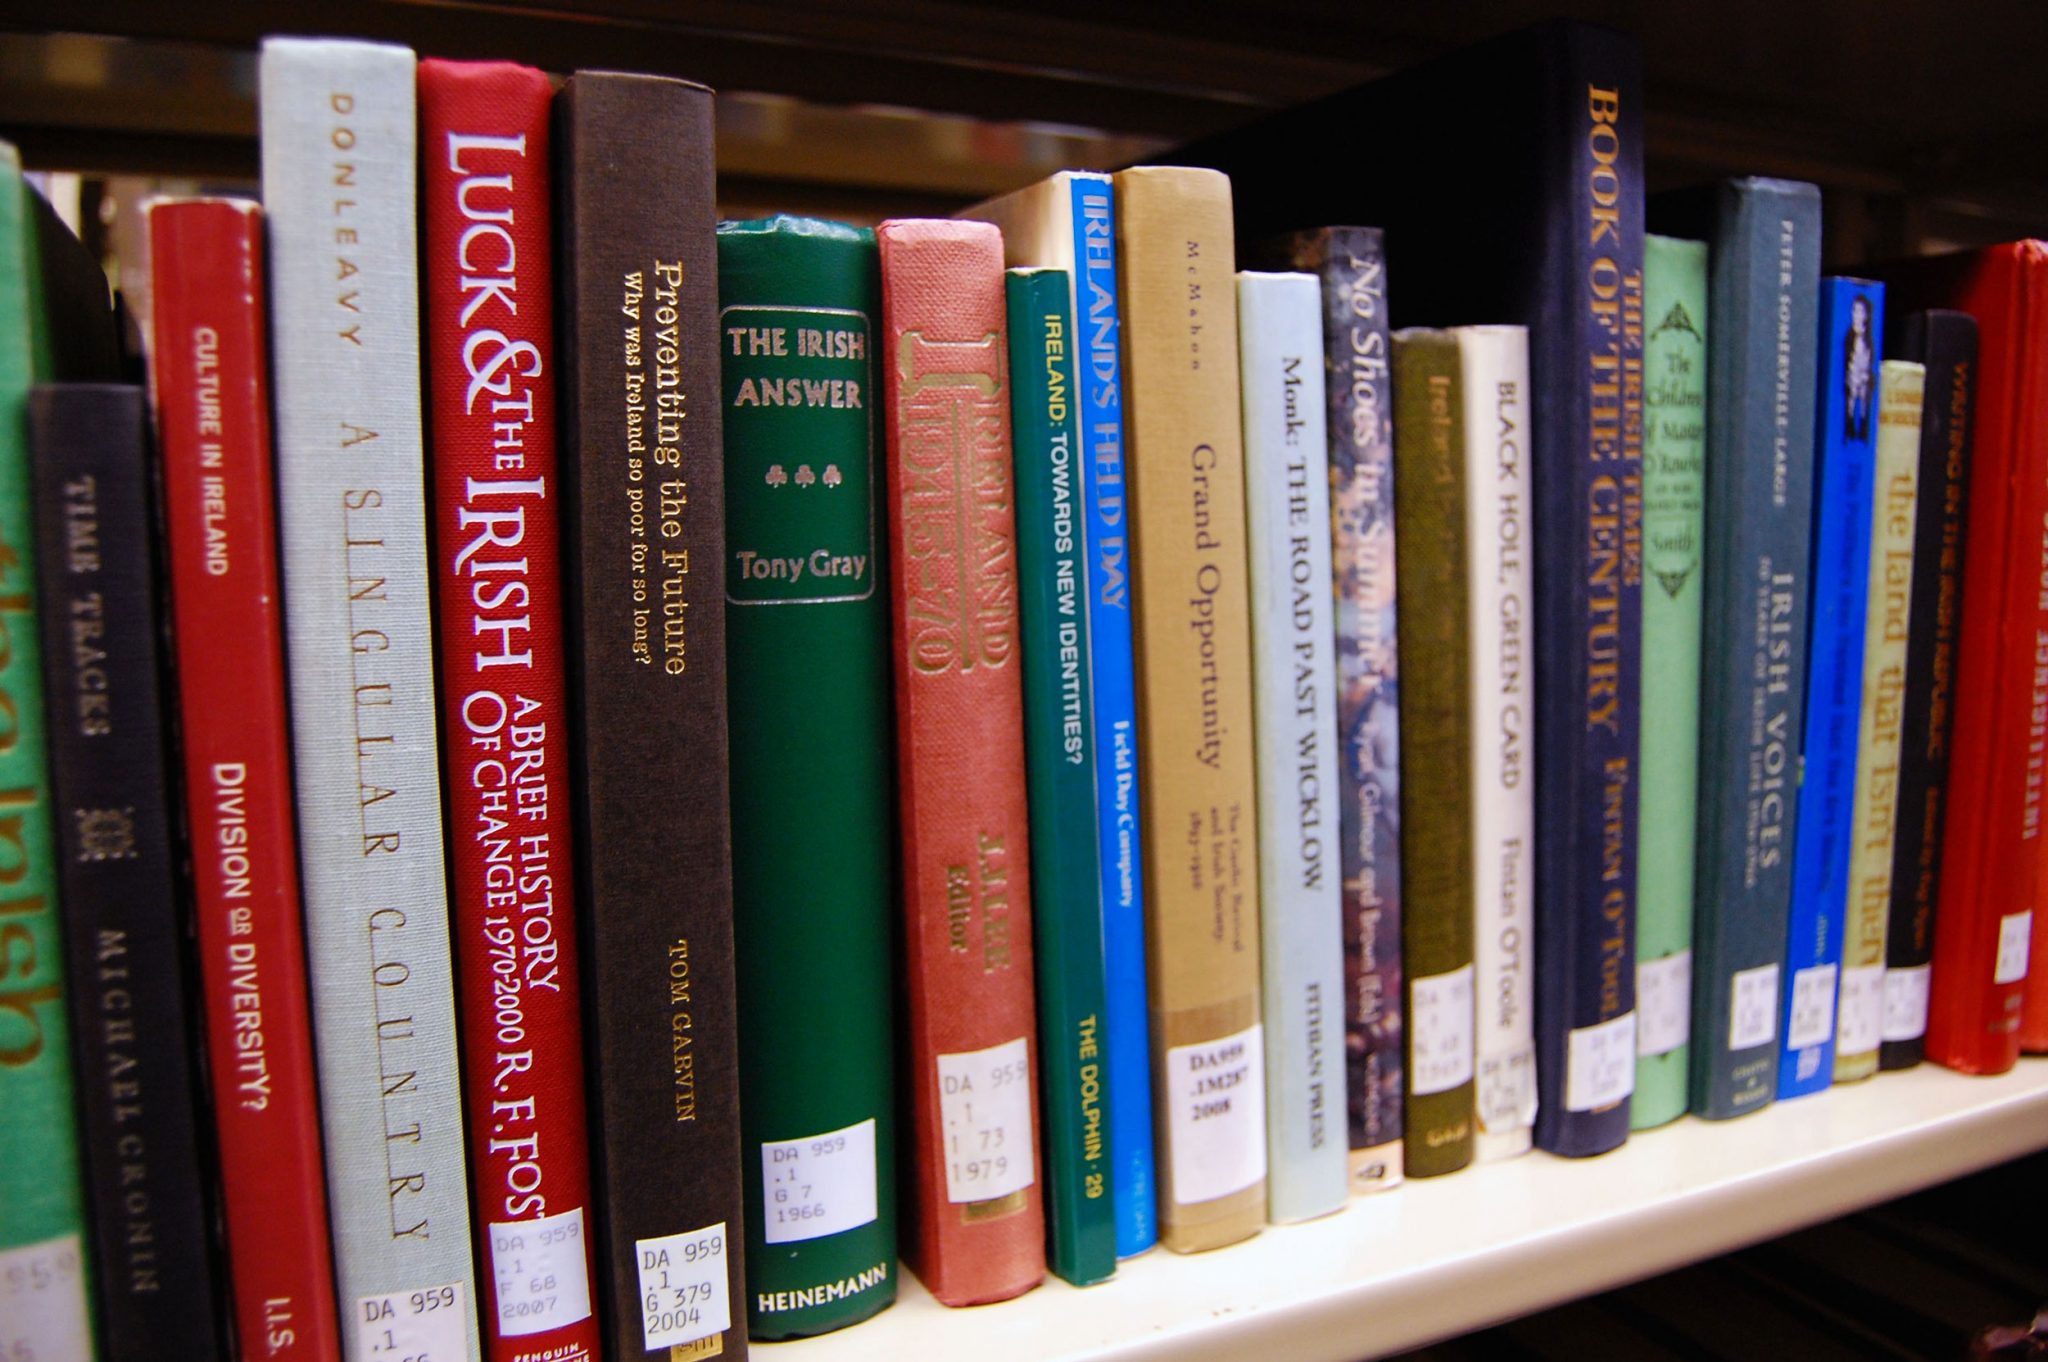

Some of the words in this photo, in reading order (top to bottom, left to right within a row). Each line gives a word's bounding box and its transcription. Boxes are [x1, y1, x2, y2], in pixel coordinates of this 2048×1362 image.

[1588, 83, 1620, 248] BOOK
[331, 93, 362, 347] DONLEAVY
[447, 131, 527, 328] LUCK
[1779, 220, 1795, 288] PETER
[622, 271, 644, 320] Why
[1187, 240, 1202, 371] McMahon
[1350, 255, 1381, 319] No
[1589, 257, 1620, 336] OF
[1623, 268, 1643, 350] THE
[193, 326, 222, 436] CULTURE
[462, 329, 543, 416] &
[625, 325, 642, 366] was
[654, 259, 686, 468] Preventing
[727, 327, 788, 356] THE
[797, 328, 865, 360] IRISH
[1045, 315, 1067, 427] IRELAND:
[626, 372, 646, 453] Ireland
[734, 378, 863, 409] ANSWER
[1282, 357, 1307, 446] Monk:
[1351, 328, 1387, 448] Shoes
[1590, 343, 1620, 462] THE
[1623, 357, 1643, 461] IRISH
[1946, 361, 1968, 481] WRITING
[202, 444, 223, 467] IN
[340, 422, 379, 448] A
[492, 389, 534, 470] THE
[628, 458, 643, 482] so
[1498, 380, 1519, 480] BLACK
[627, 489, 644, 537] poor
[660, 479, 688, 538] the
[1050, 432, 1073, 554] TOWARDS
[1191, 443, 1221, 550] Grand
[1286, 457, 1308, 527] THE
[1354, 464, 1381, 501] in
[1886, 470, 1915, 538] the
[1945, 484, 1960, 514] IN
[66, 474, 102, 573] TIME
[203, 476, 229, 576] IRELAND
[631, 543, 648, 573] for
[1498, 491, 1520, 584] HOLE,
[1622, 468, 1643, 587] TIMES
[1940, 523, 1958, 570] THE
[455, 476, 545, 672] IRISH
[632, 579, 647, 602] so
[736, 550, 804, 583] Tony
[809, 549, 866, 580] Gray
[1057, 560, 1076, 616] NEW
[1290, 537, 1312, 631] ROAD
[1355, 519, 1383, 692] Summer
[1587, 474, 1620, 737] CENTURY
[1883, 550, 1912, 644] land
[632, 608, 652, 665] long?
[662, 549, 689, 675] Future
[1499, 593, 1521, 695] GREEN
[1767, 572, 1795, 695] IRISH
[72, 592, 111, 736] TRACKS
[343, 489, 400, 857] SINGULAR
[1059, 622, 1083, 765] IDENTITIES?
[1190, 564, 1228, 770] Opportunity
[1294, 642, 1316, 720] PAST
[1872, 665, 1904, 744] that
[462, 690, 507, 751] OF
[514, 694, 543, 721] A
[1500, 703, 1521, 790] CARD
[510, 722, 548, 821] BRIEF
[1297, 731, 1322, 892] WICKLOW
[1758, 710, 1787, 870] VOICES
[214, 762, 251, 898] DIVISION
[473, 759, 517, 908] CHANGE
[1359, 782, 1381, 862] Gilmour
[519, 833, 560, 992] HISTORY
[947, 865, 971, 953] Editor
[1500, 838, 1521, 919] Fintan
[229, 907, 253, 935] OR
[1359, 911, 1382, 972] Brown
[1602, 887, 1626, 1020] O'TOOL
[484, 916, 525, 1043] 1970-2000
[668, 939, 689, 1005] TOM
[1499, 926, 1521, 1029] O'Toole
[98, 929, 142, 1122] MICHAEL
[228, 943, 271, 1111] DIVERSITY?
[1079, 1014, 1097, 1061] THE
[369, 907, 431, 1240] COUNTRY
[494, 1049, 534, 1093] R.
[672, 1015, 696, 1122] GARVIN
[945, 1075, 973, 1095] DA
[990, 1061, 1027, 1088] 959
[492, 1095, 536, 1132] F.
[773, 1148, 799, 1163] DA
[811, 1136, 846, 1157] 959
[951, 1103, 972, 1125] .1
[979, 1128, 1004, 1149] 73
[1080, 1064, 1103, 1161] DOLPHIN
[1309, 1084, 1325, 1151] PRESS
[490, 1132, 546, 1219] FOS
[774, 1168, 797, 1183] .1
[775, 1188, 788, 1203] G
[802, 1185, 812, 1199] 7
[952, 1157, 1009, 1183] 1979
[117, 1134, 160, 1291] CRONIN
[496, 1236, 524, 1252] DA
[539, 1223, 580, 1245] 959
[643, 1249, 670, 1270] DA
[684, 1236, 722, 1263] 959
[777, 1203, 826, 1223] 1966
[365, 1300, 395, 1322] DA
[411, 1287, 455, 1314] 959
[501, 1259, 524, 1275] .1
[530, 1276, 557, 1293] 68
[646, 1293, 658, 1312] G
[673, 1281, 712, 1309] 379
[649, 1271, 670, 1291] .1
[758, 1262, 887, 1314] HEINEMANN
[373, 1330, 398, 1352] .1
[503, 1297, 558, 1319] 2007
[647, 1307, 701, 1334] 2004
